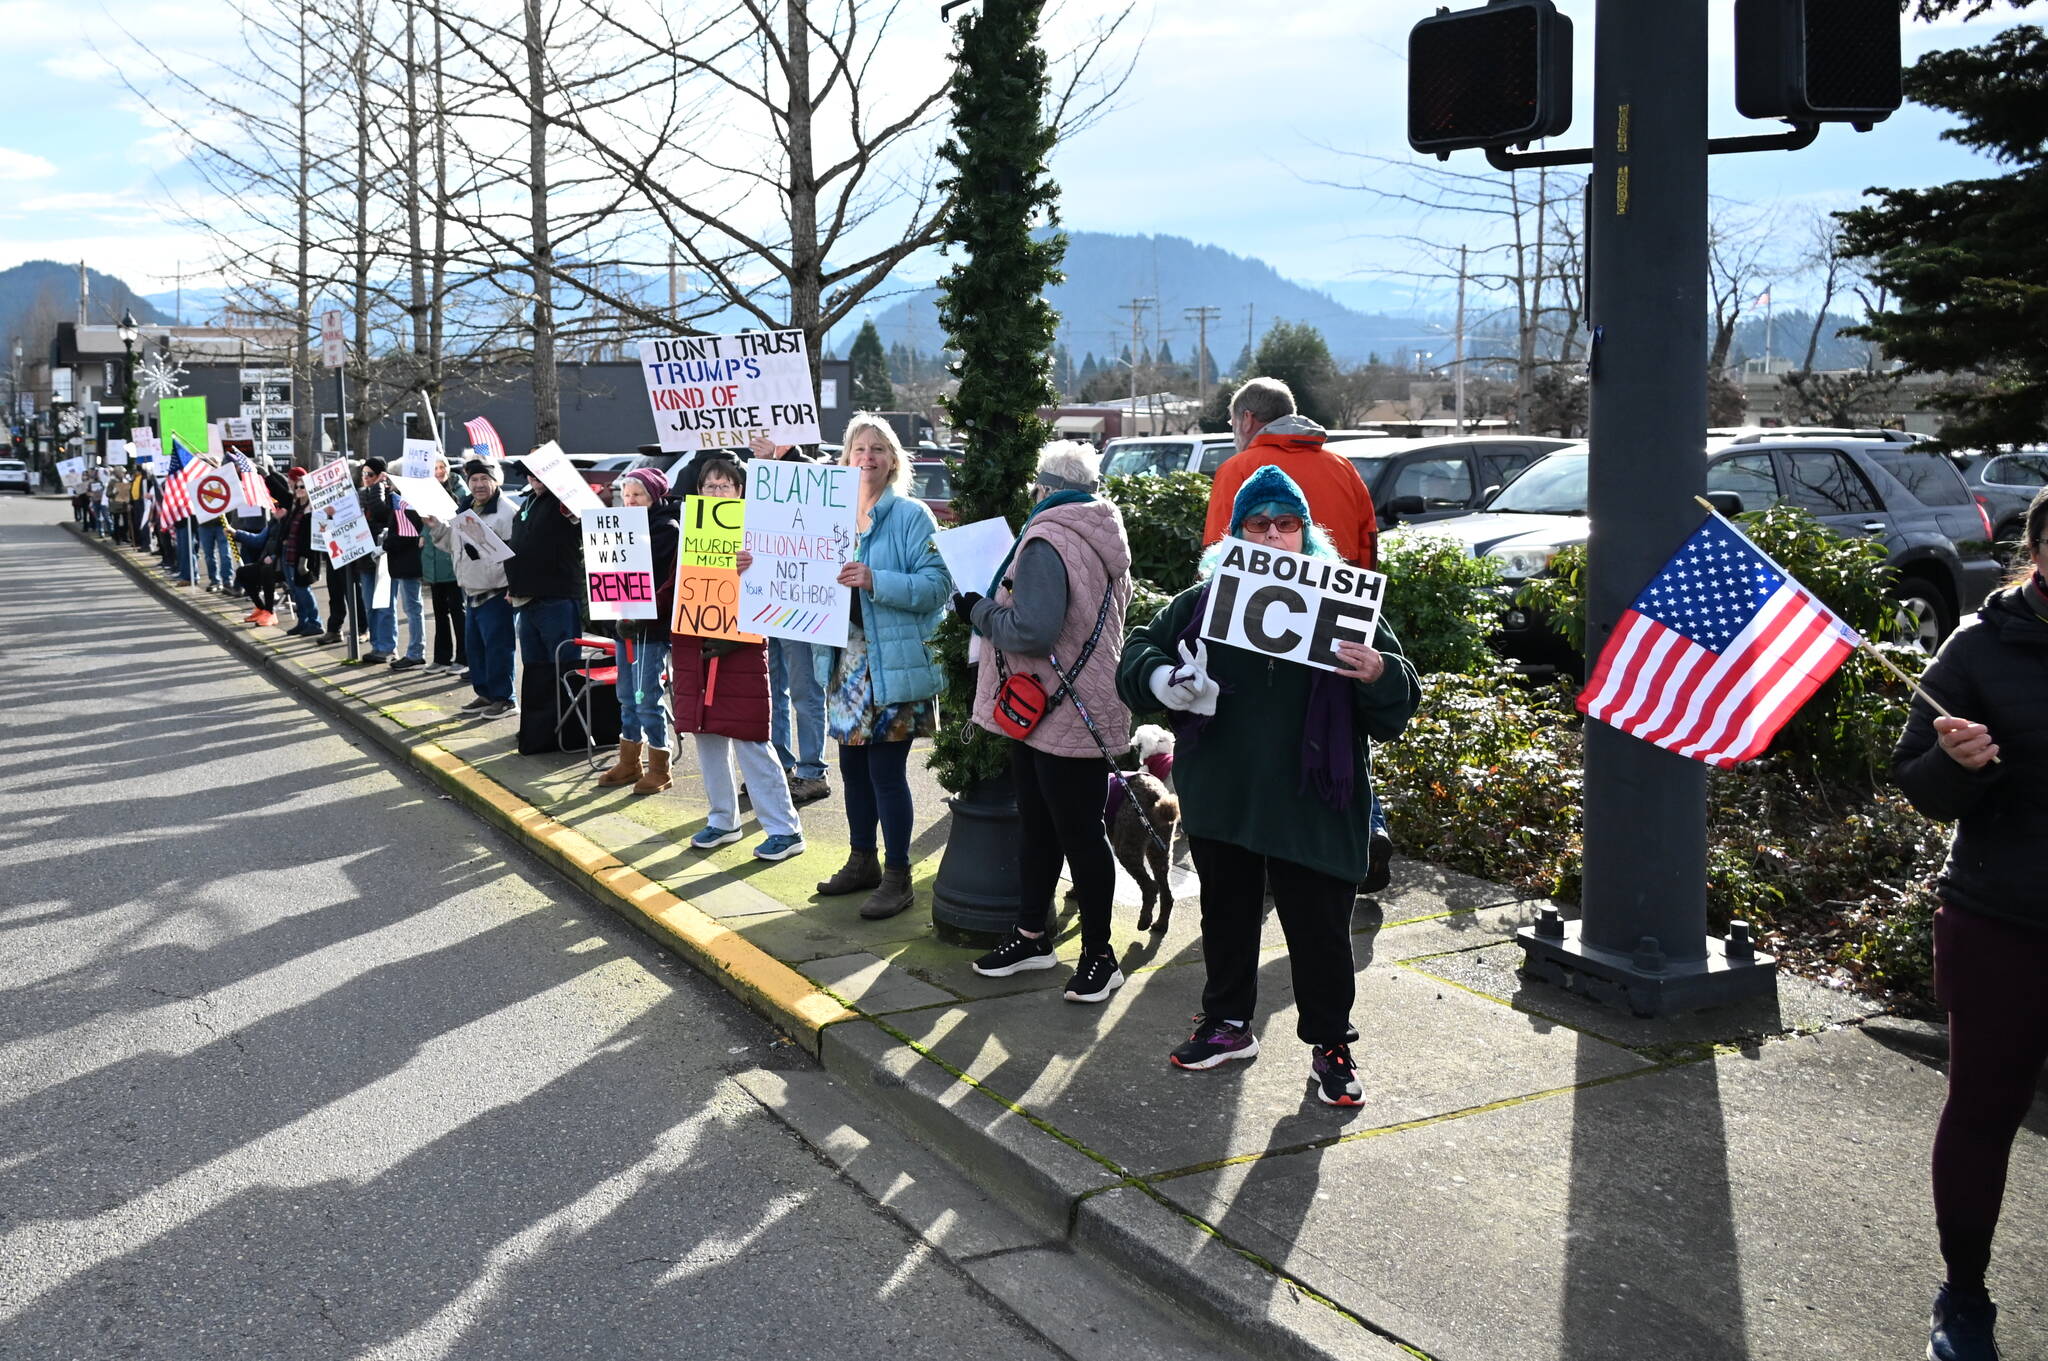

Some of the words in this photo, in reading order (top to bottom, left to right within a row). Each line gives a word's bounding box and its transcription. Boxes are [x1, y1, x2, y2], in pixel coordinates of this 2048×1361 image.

[654, 337, 721, 362] DON'T
[735, 331, 803, 357] TRUST
[649, 357, 761, 385] TRUMP'S
[652, 387, 704, 411] KIND
[711, 384, 738, 407] OF
[671, 406, 763, 432] JUSTICE
[771, 403, 815, 426] FOR
[317, 466, 340, 484] STOP
[756, 465, 847, 508] BLAME
[597, 515, 619, 529] HER
[696, 498, 741, 529] IC
[792, 507, 805, 532] A
[331, 520, 358, 538] HISTORY
[590, 532, 634, 546] NAME
[341, 547, 366, 563] SILENCE
[599, 549, 627, 563] WAS
[685, 536, 741, 554] MURDE
[697, 555, 733, 567] MUST
[776, 560, 808, 582] NOT
[1222, 545, 1382, 601] ABOLISH
[588, 571, 652, 601] RENEE
[681, 577, 736, 605] STO
[770, 581, 837, 607] NEIGHBOR
[1207, 573, 1375, 671] ICE
